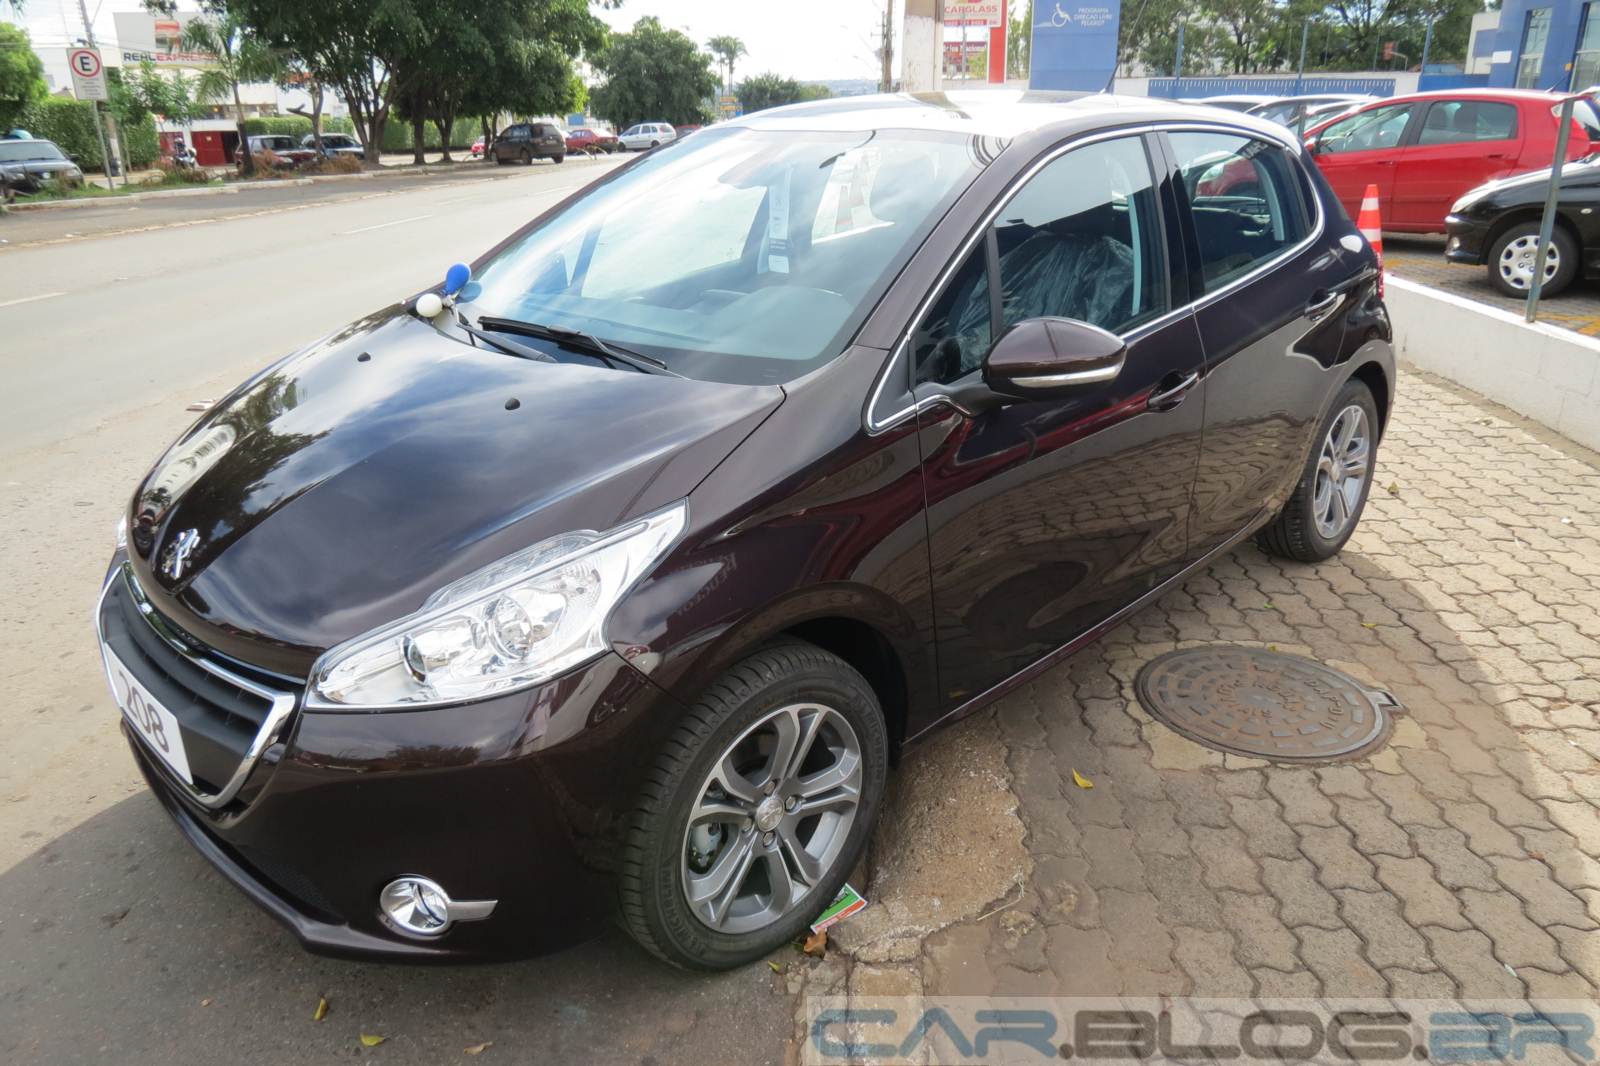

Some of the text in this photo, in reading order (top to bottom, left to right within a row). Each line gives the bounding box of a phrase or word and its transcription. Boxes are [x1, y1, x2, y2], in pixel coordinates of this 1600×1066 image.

[944, 5, 998, 13] CARGLASS
[80, 56, 92, 71] E
[118, 669, 170, 753] 208
